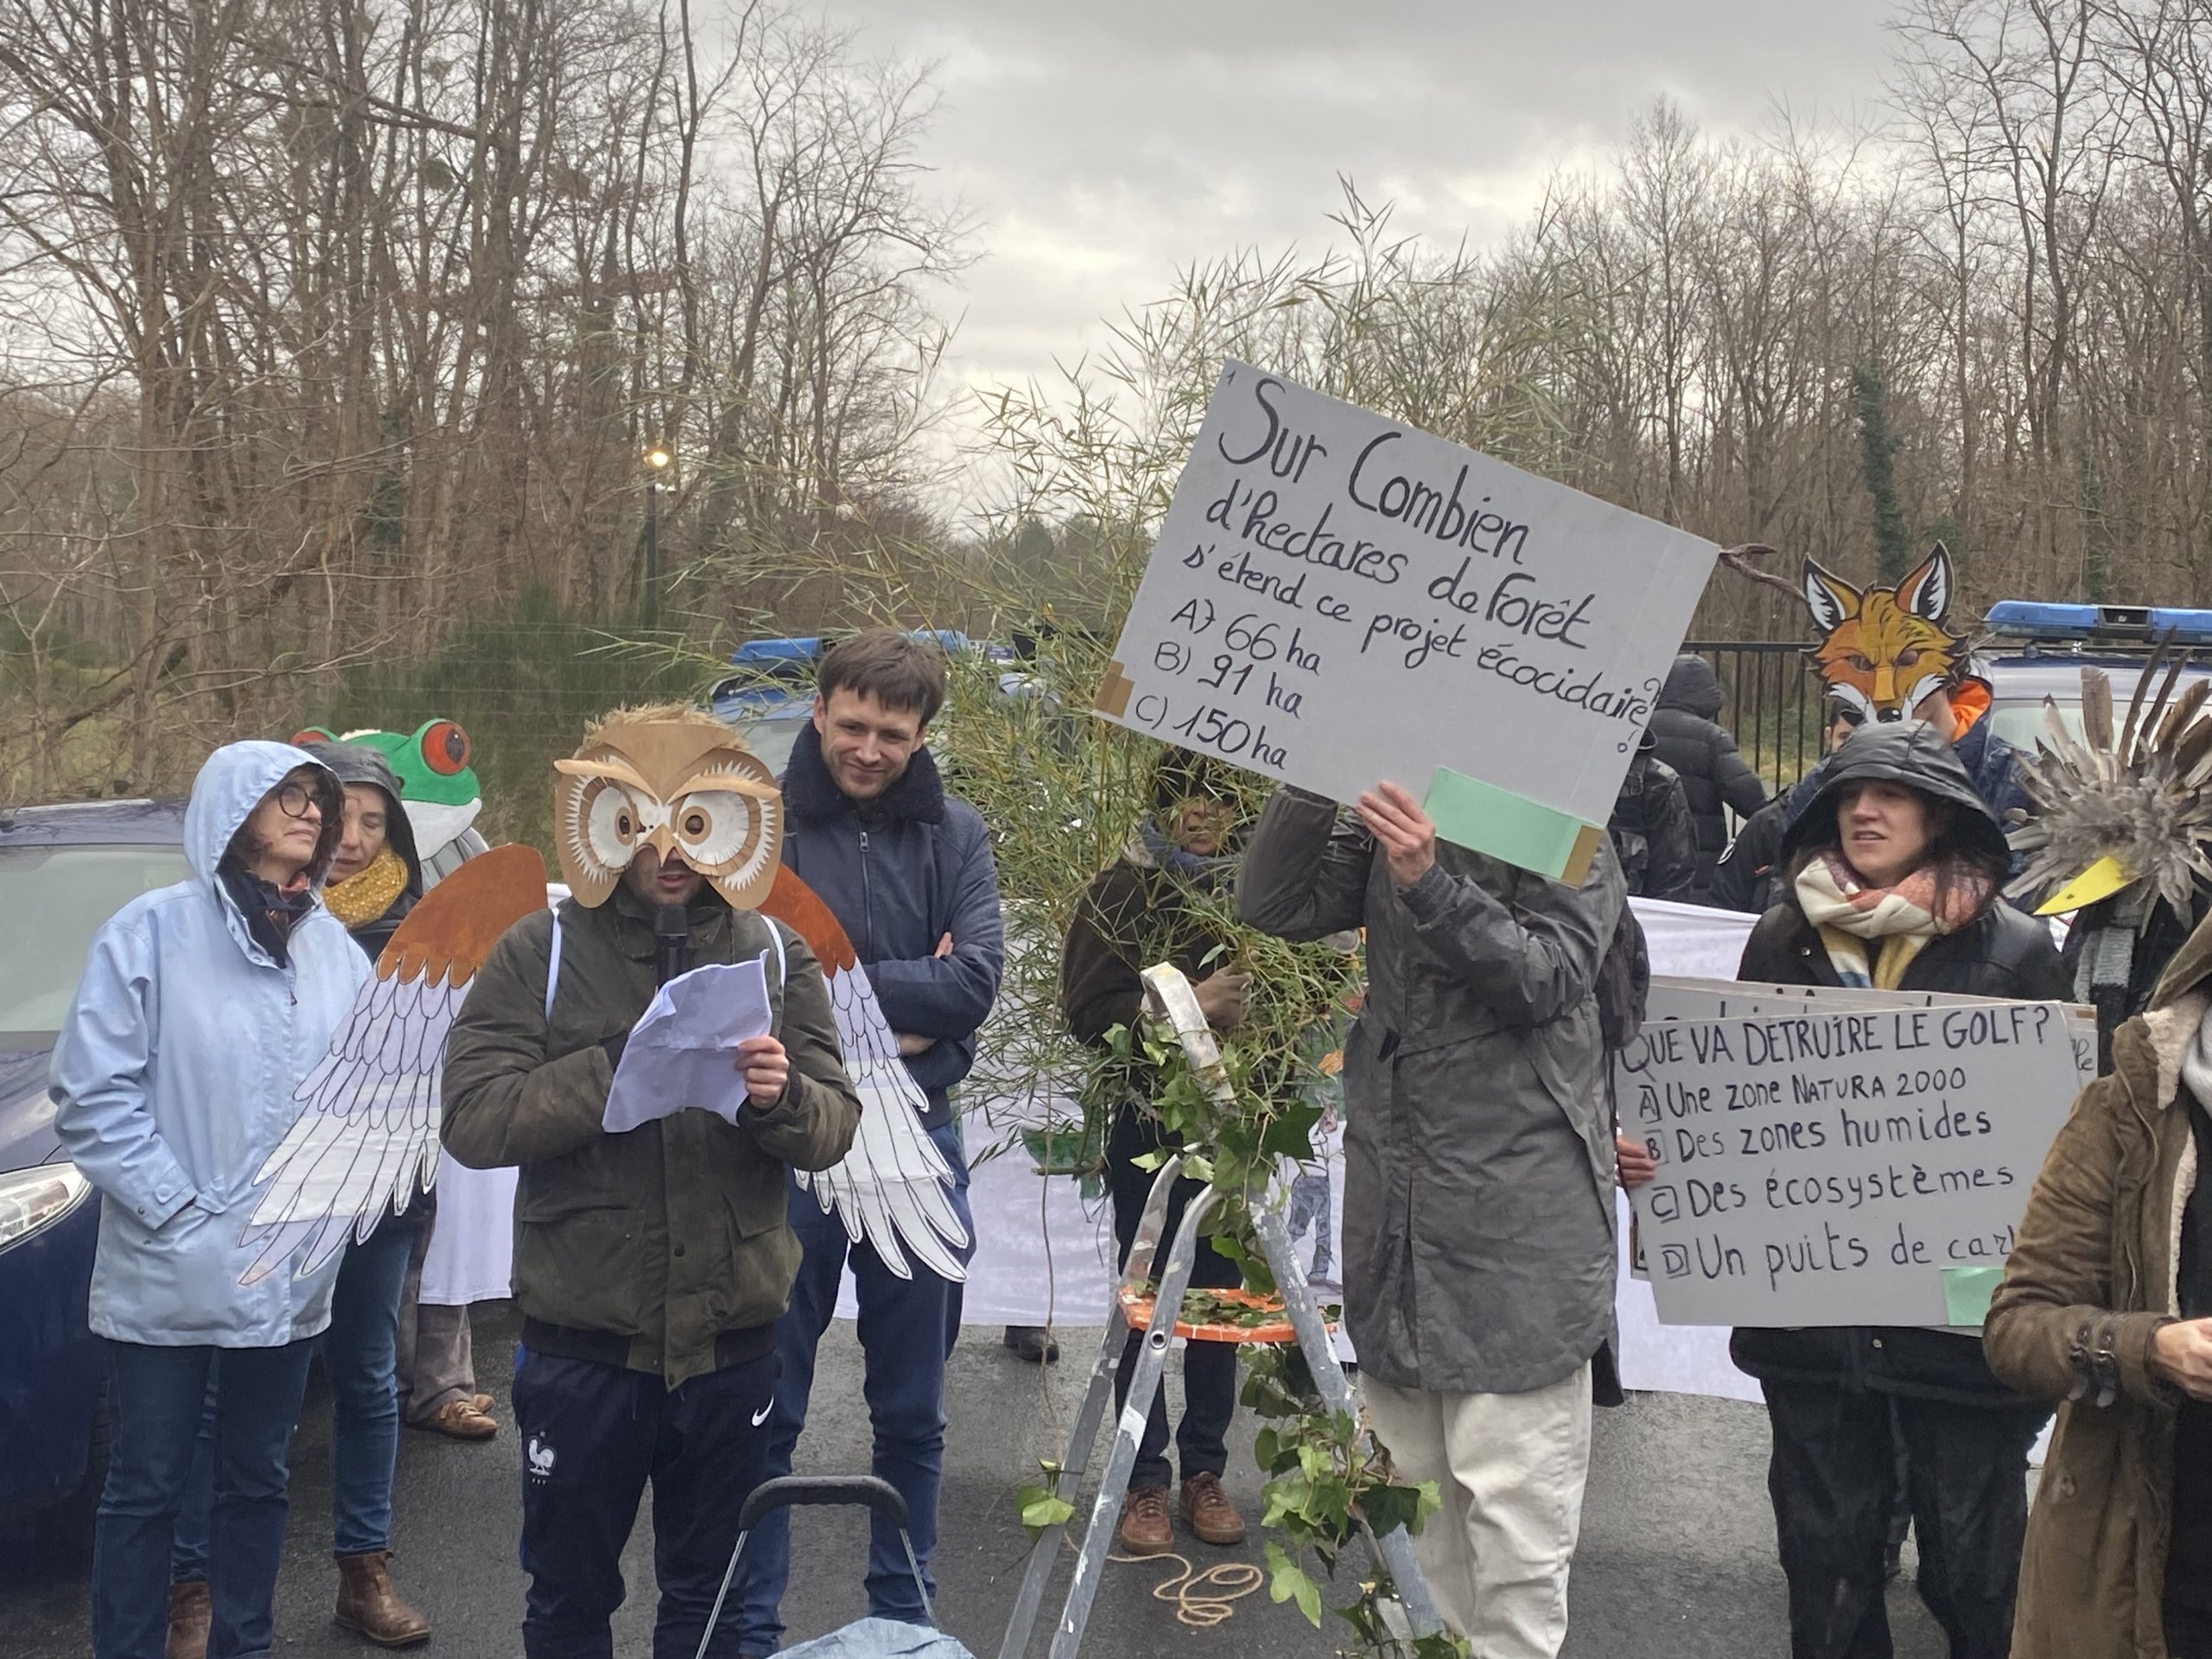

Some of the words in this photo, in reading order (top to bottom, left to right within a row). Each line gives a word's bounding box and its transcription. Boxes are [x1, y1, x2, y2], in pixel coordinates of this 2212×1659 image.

[1218, 378, 1327, 483] Sur
[1349, 432, 1529, 565] Combien
[1225, 613, 1281, 660] 66
[1286, 627, 1320, 677] ha
[1317, 595, 1351, 622] ce
[1361, 614, 1467, 670] projet
[1134, 695, 1168, 730] C)
[1154, 641, 1191, 676] B)
[1198, 654, 1254, 696] 91
[1266, 671, 1303, 721] ha
[1621, 1028, 1683, 1083] QUE
[1690, 1025, 1734, 1065] VA
[1896, 1014, 1929, 1050] LE
[1667, 1082, 1712, 1117] Une
[1726, 1081, 1781, 1110] zone
[1791, 1073, 1885, 1104] NATURA
[1897, 1067, 1966, 1096] 2000
[1676, 1128, 1724, 1163] Des
[1740, 1122, 1826, 1154] zones
[1841, 1099, 1991, 1147] humides
[1687, 1179, 1745, 1217] Des
[1766, 1164, 2014, 1209] écosystèmes
[1696, 1234, 1745, 1279] Un
[1766, 1221, 1869, 1292] puits
[1891, 1222, 1932, 1265] de
